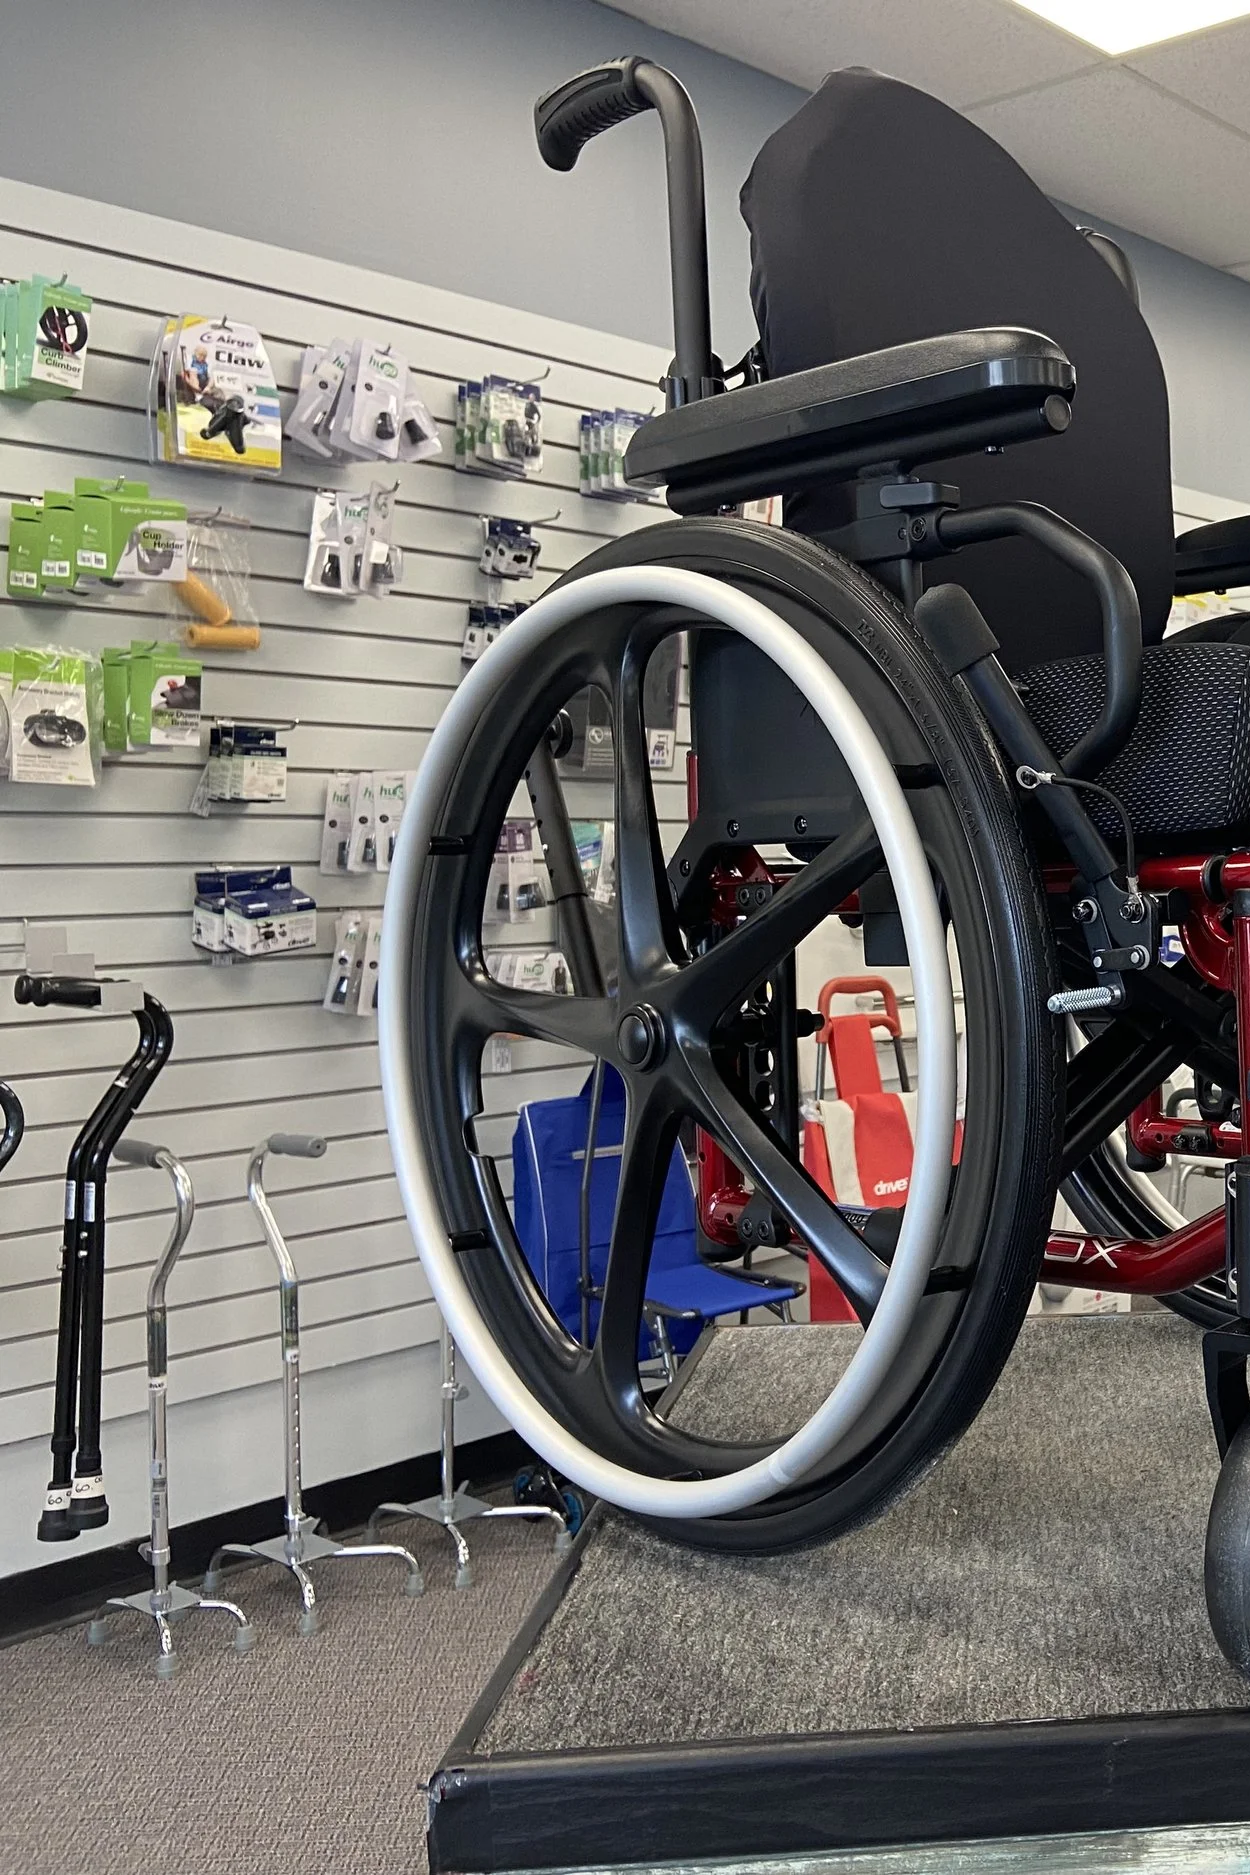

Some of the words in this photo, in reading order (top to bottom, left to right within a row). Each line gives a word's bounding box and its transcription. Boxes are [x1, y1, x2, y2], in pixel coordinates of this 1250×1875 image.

[217, 335, 254, 347] Airgo
[41, 347, 63, 359] Curb
[215, 350, 264, 368] Claw
[45, 358, 81, 373] Climber
[142, 531, 162, 541] Cup
[153, 541, 184, 550] Holder
[873, 1178, 908, 1196] drive
